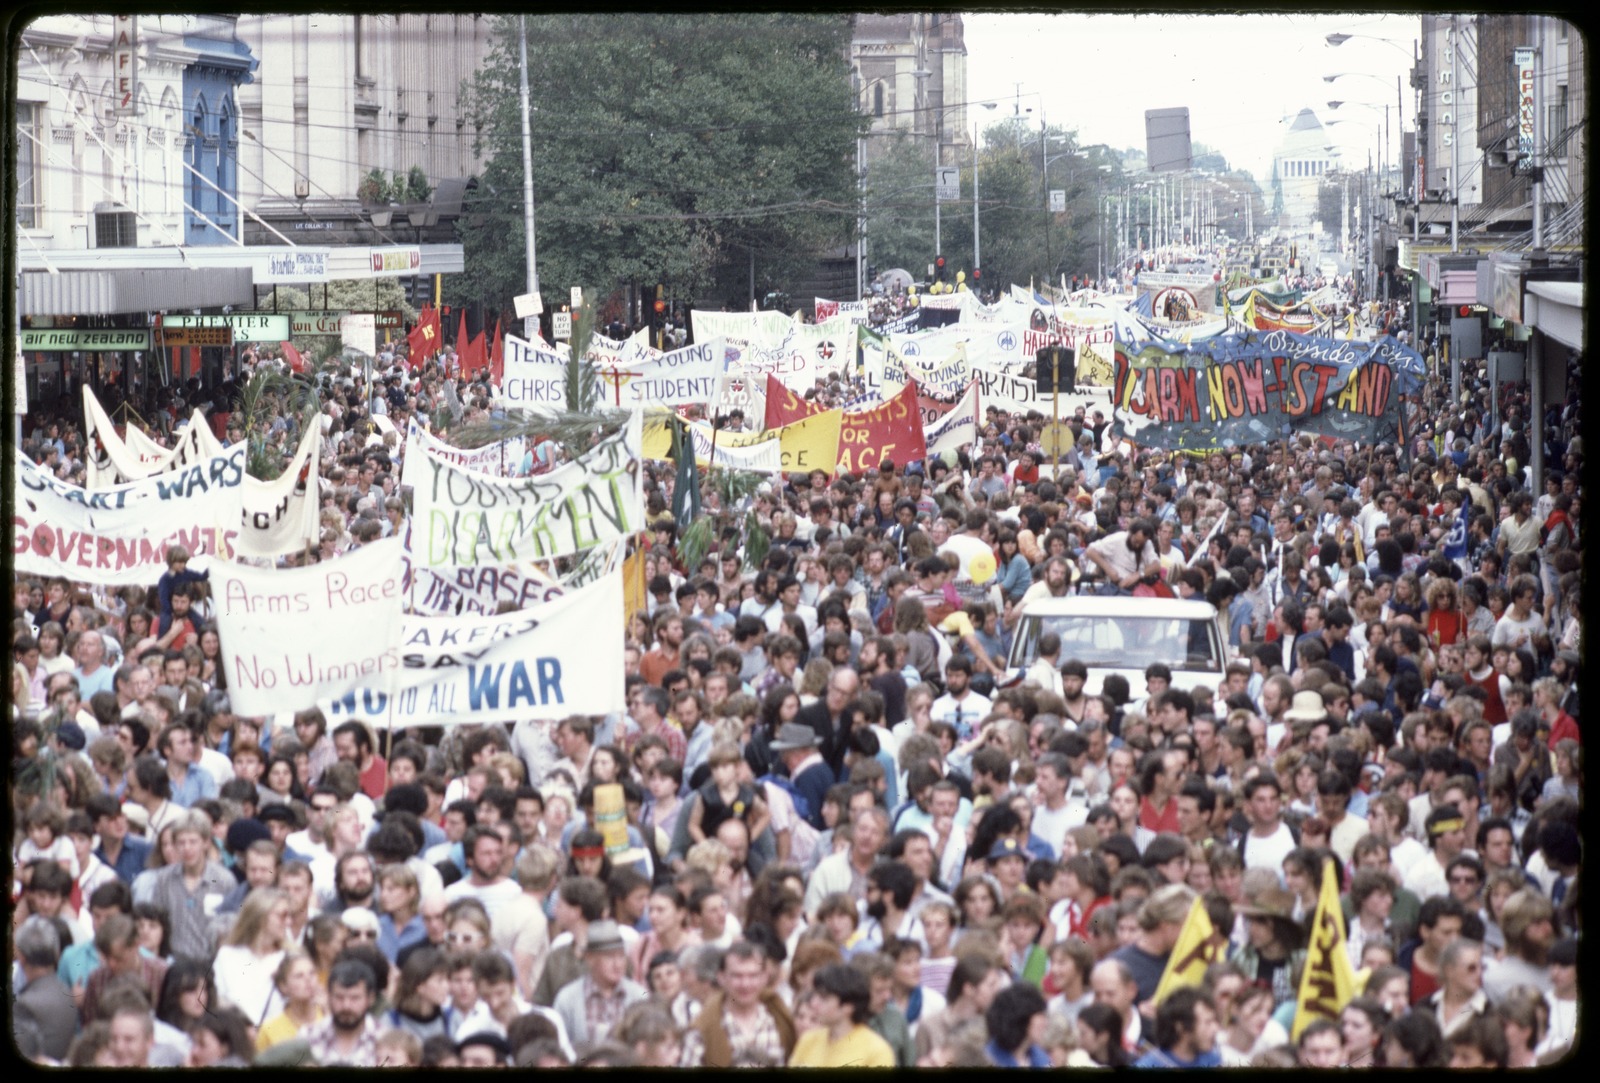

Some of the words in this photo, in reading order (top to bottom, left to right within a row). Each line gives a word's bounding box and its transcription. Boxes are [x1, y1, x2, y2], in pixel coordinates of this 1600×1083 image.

[1440, 27, 1453, 148] rtmans
[25, 334, 45, 344] air
[49, 334, 79, 344] new
[182, 316, 270, 329] PREMIER
[375, 316, 398, 324] llers
[655, 343, 714, 368] YOUNG
[1336, 361, 1392, 417] AND
[842, 428, 870, 444] OR
[156, 449, 244, 500] WARS
[226, 578, 310, 614] Arms
[326, 571, 397, 609] Race
[236, 653, 277, 689] No
[286, 645, 400, 688] Winners
[428, 681, 457, 714] ALL
[467, 656, 566, 711] WAR
